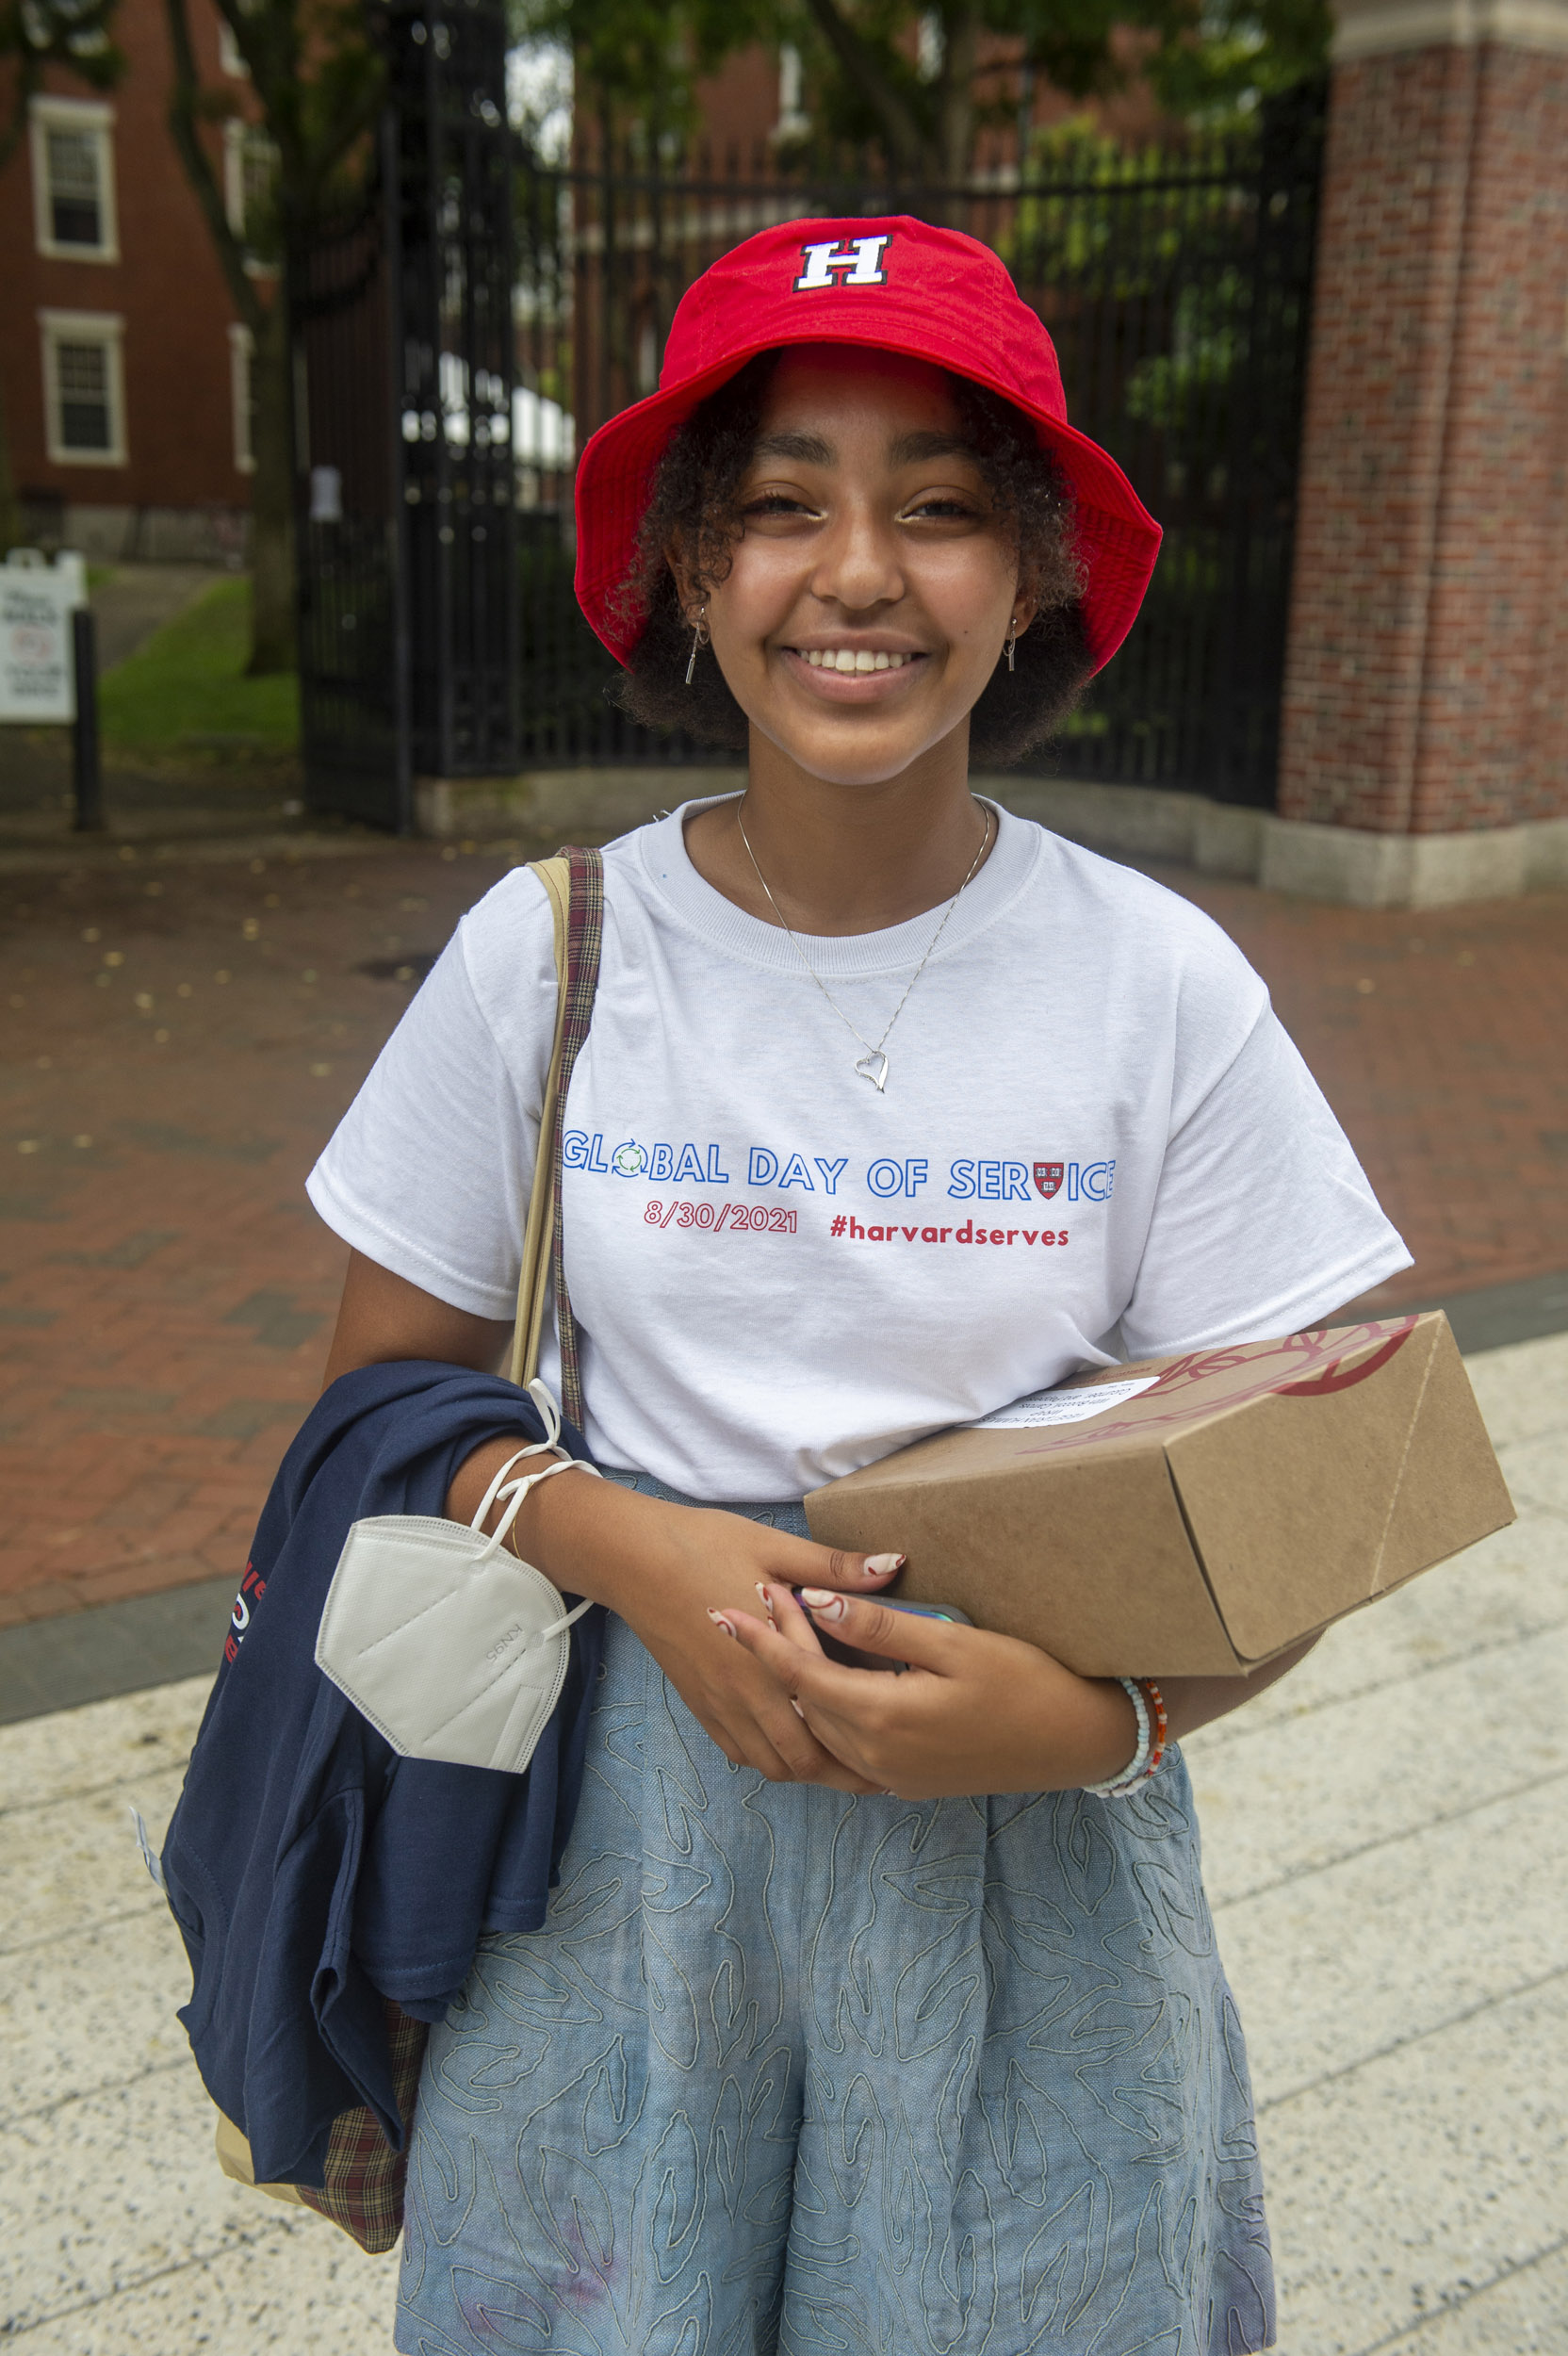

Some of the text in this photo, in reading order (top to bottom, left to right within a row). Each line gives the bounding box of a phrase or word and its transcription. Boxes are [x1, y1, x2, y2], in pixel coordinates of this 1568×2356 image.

[793, 234, 892, 292] H
[563, 1130, 1116, 1202] GLOBAL DAY OF SERVICE
[644, 1201, 797, 1233] 8/30/2021
[830, 1215, 1069, 1246] #harvardserves
[486, 1624, 523, 1663] KN95
